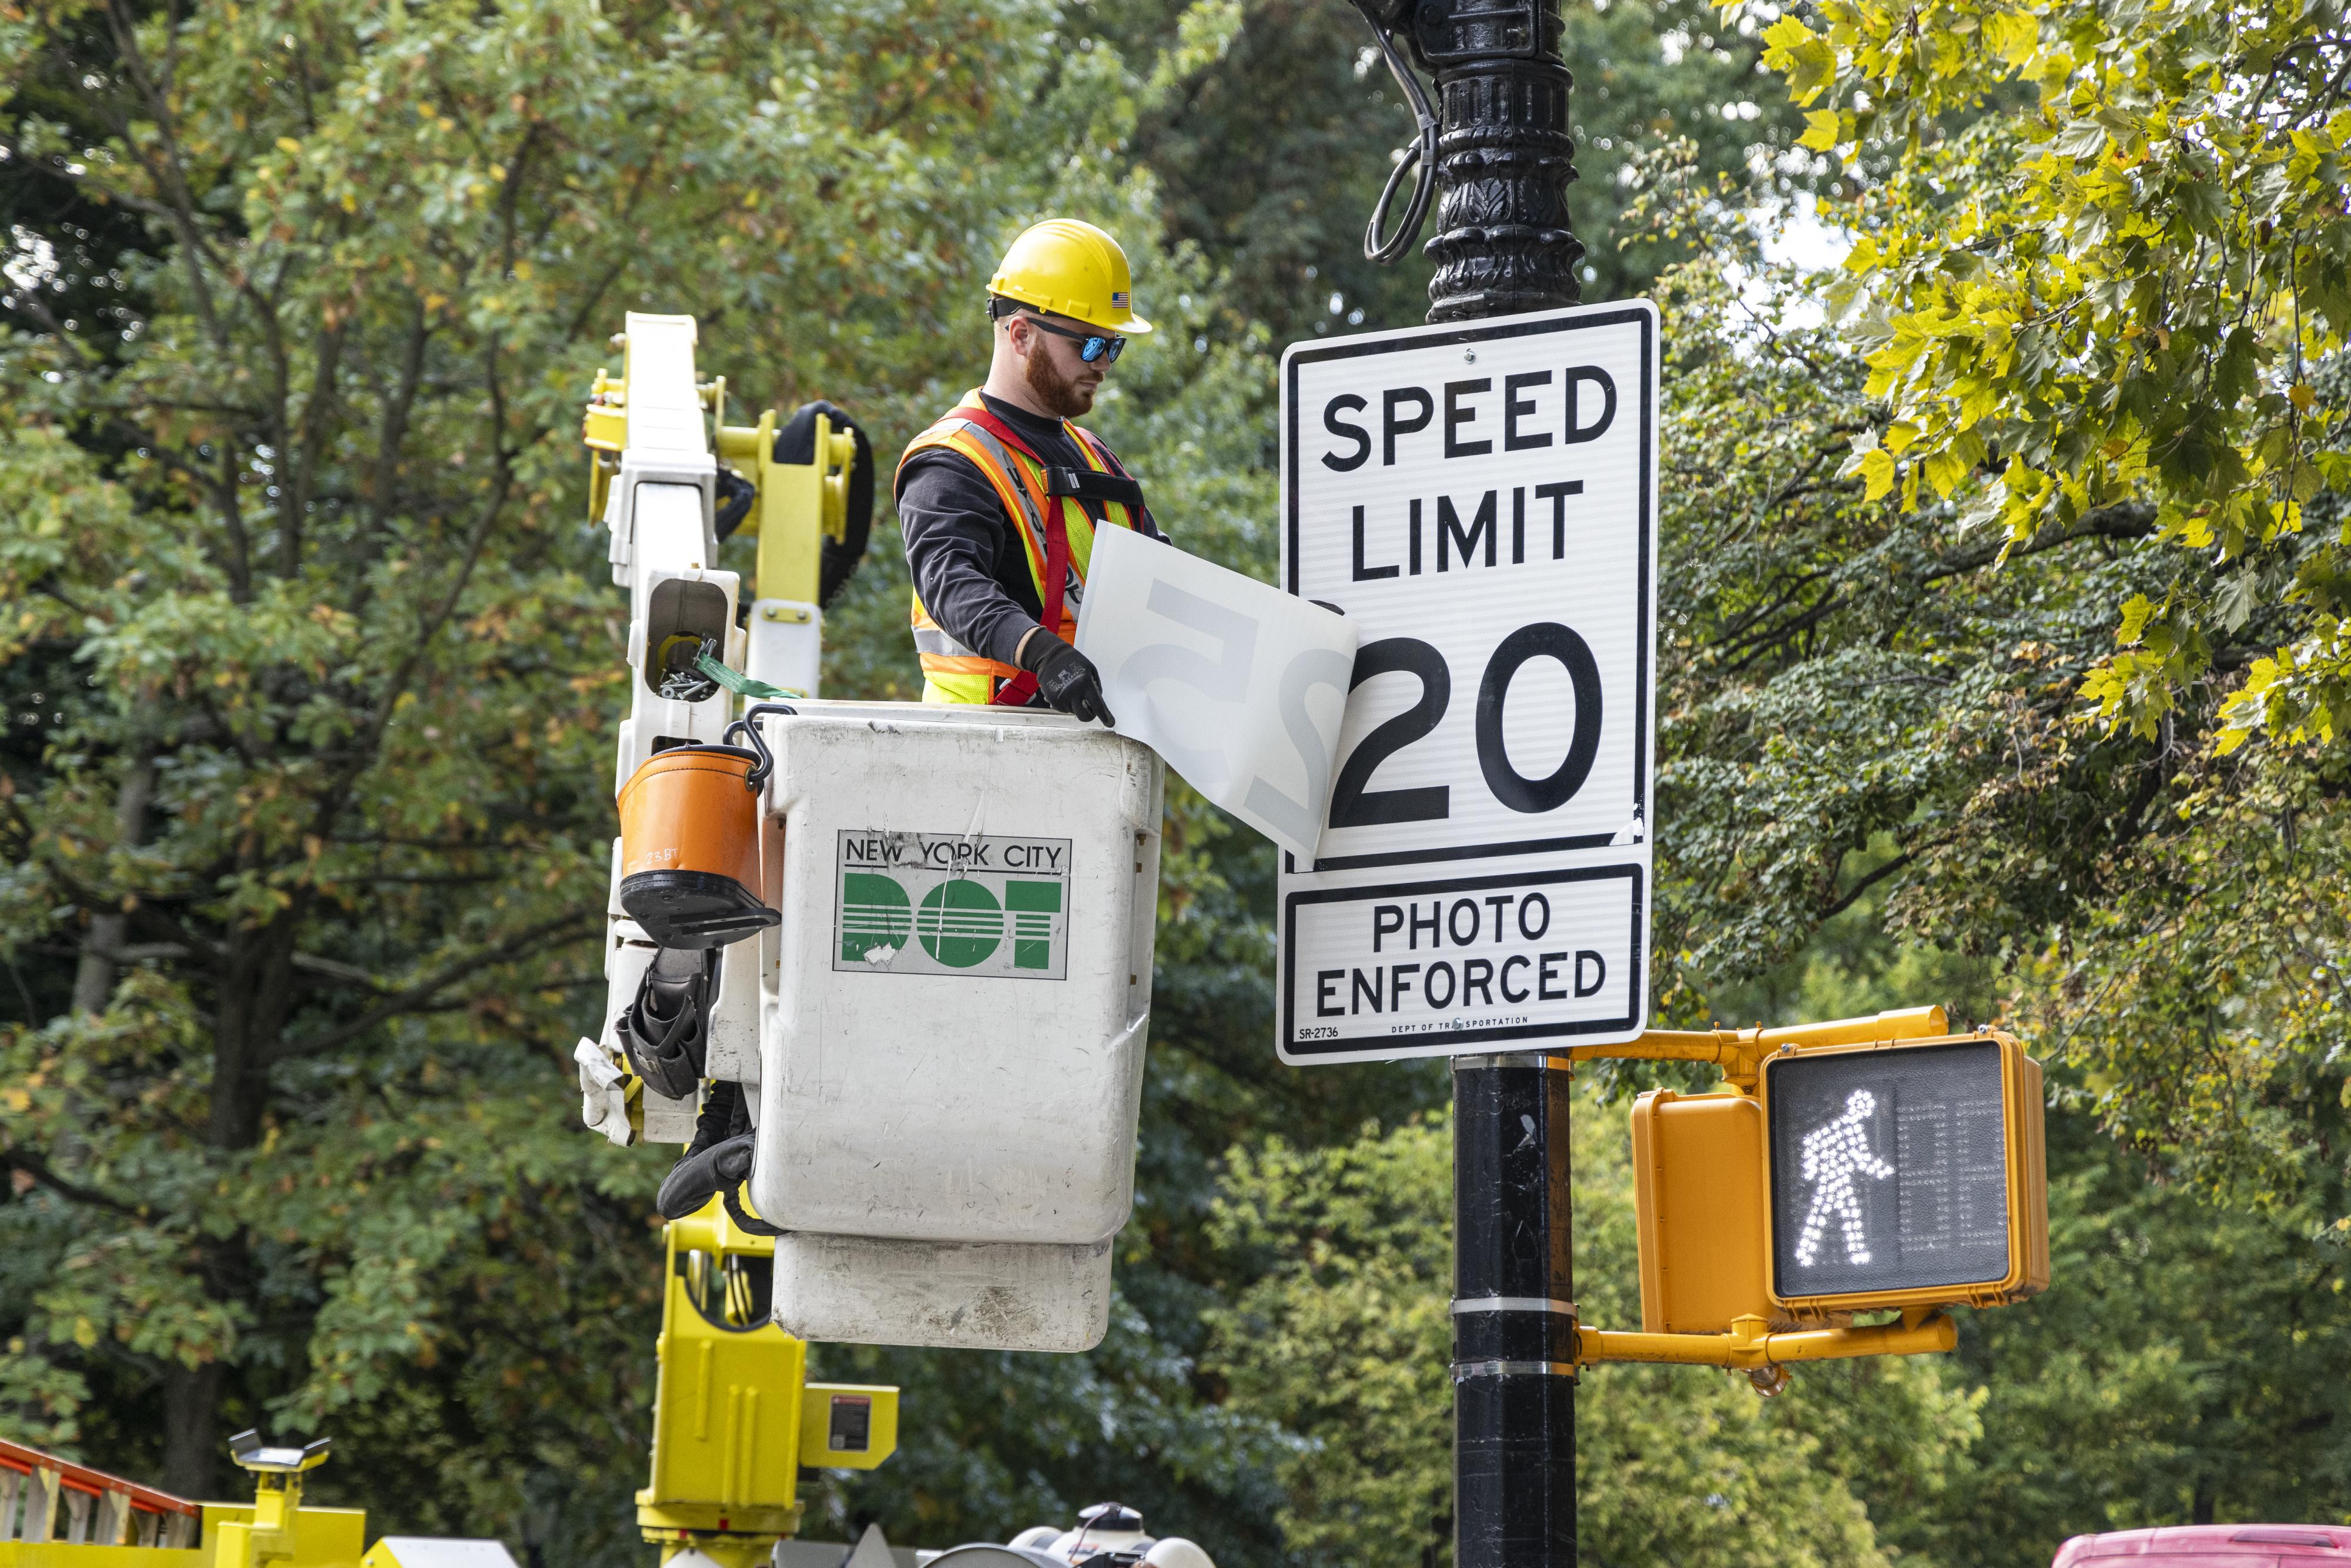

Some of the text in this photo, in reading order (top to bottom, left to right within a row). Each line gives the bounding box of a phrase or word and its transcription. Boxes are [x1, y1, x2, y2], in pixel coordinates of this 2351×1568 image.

[1321, 365, 1617, 472] SPEED
[1352, 480, 1583, 582] LIMIT
[1328, 622, 1603, 829] 20
[846, 839, 1062, 868] NEW YORK CITY
[842, 873, 1061, 970] DOT
[1373, 892, 1550, 952] PHOTO
[1317, 950, 1606, 1017] ENFORCED
[1299, 1027, 1338, 1039] SR-2736
[1439, 1017, 1528, 1030] TRSPORTATION
